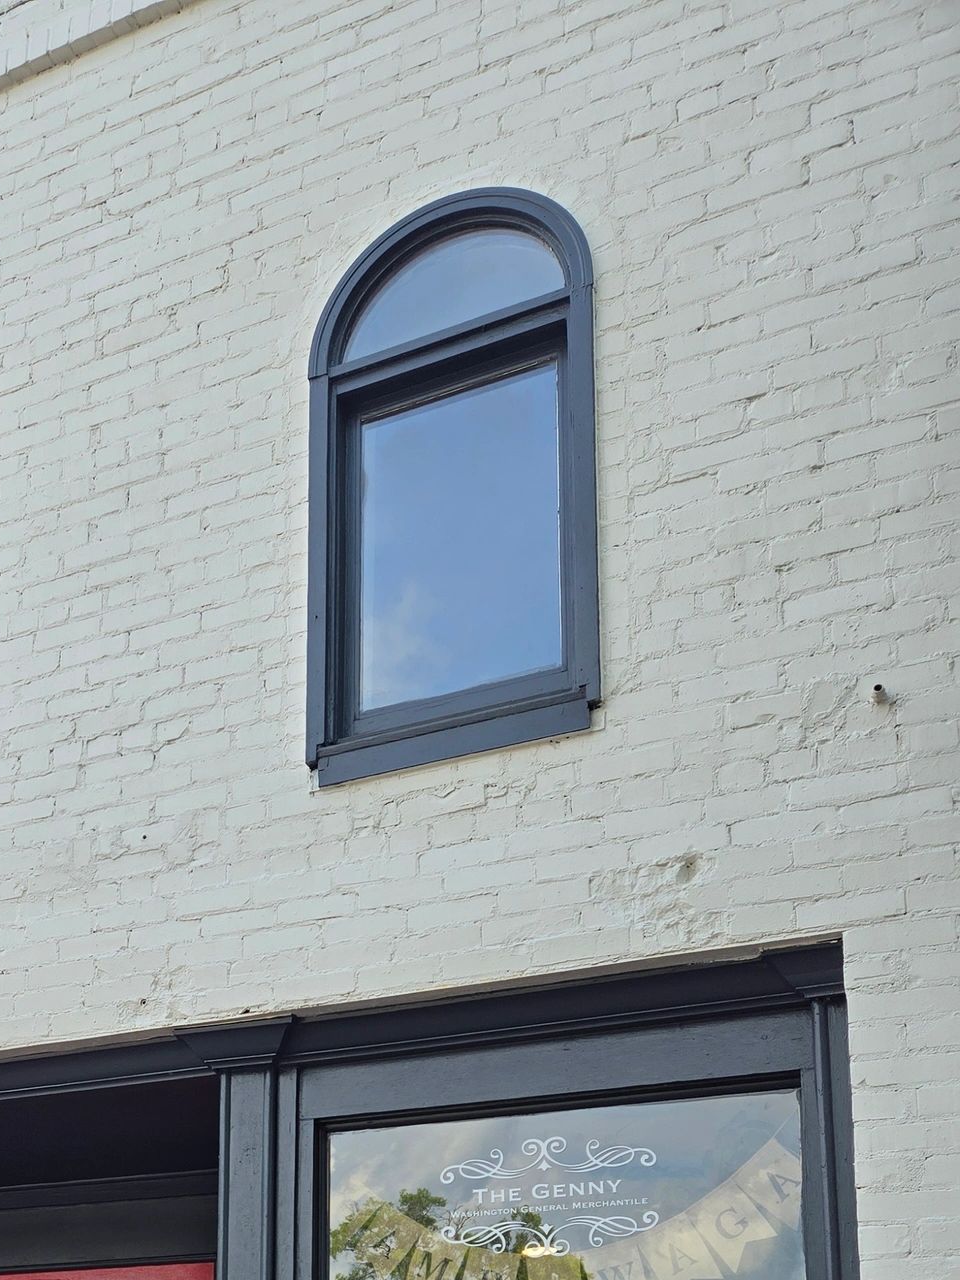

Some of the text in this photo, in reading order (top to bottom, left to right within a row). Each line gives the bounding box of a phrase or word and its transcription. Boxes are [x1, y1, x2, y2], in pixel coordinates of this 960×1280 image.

[472, 1179, 623, 1205] THE GENNY
[450, 1197, 649, 1219] WASHINGTON GENERAL MERCHANTILE
